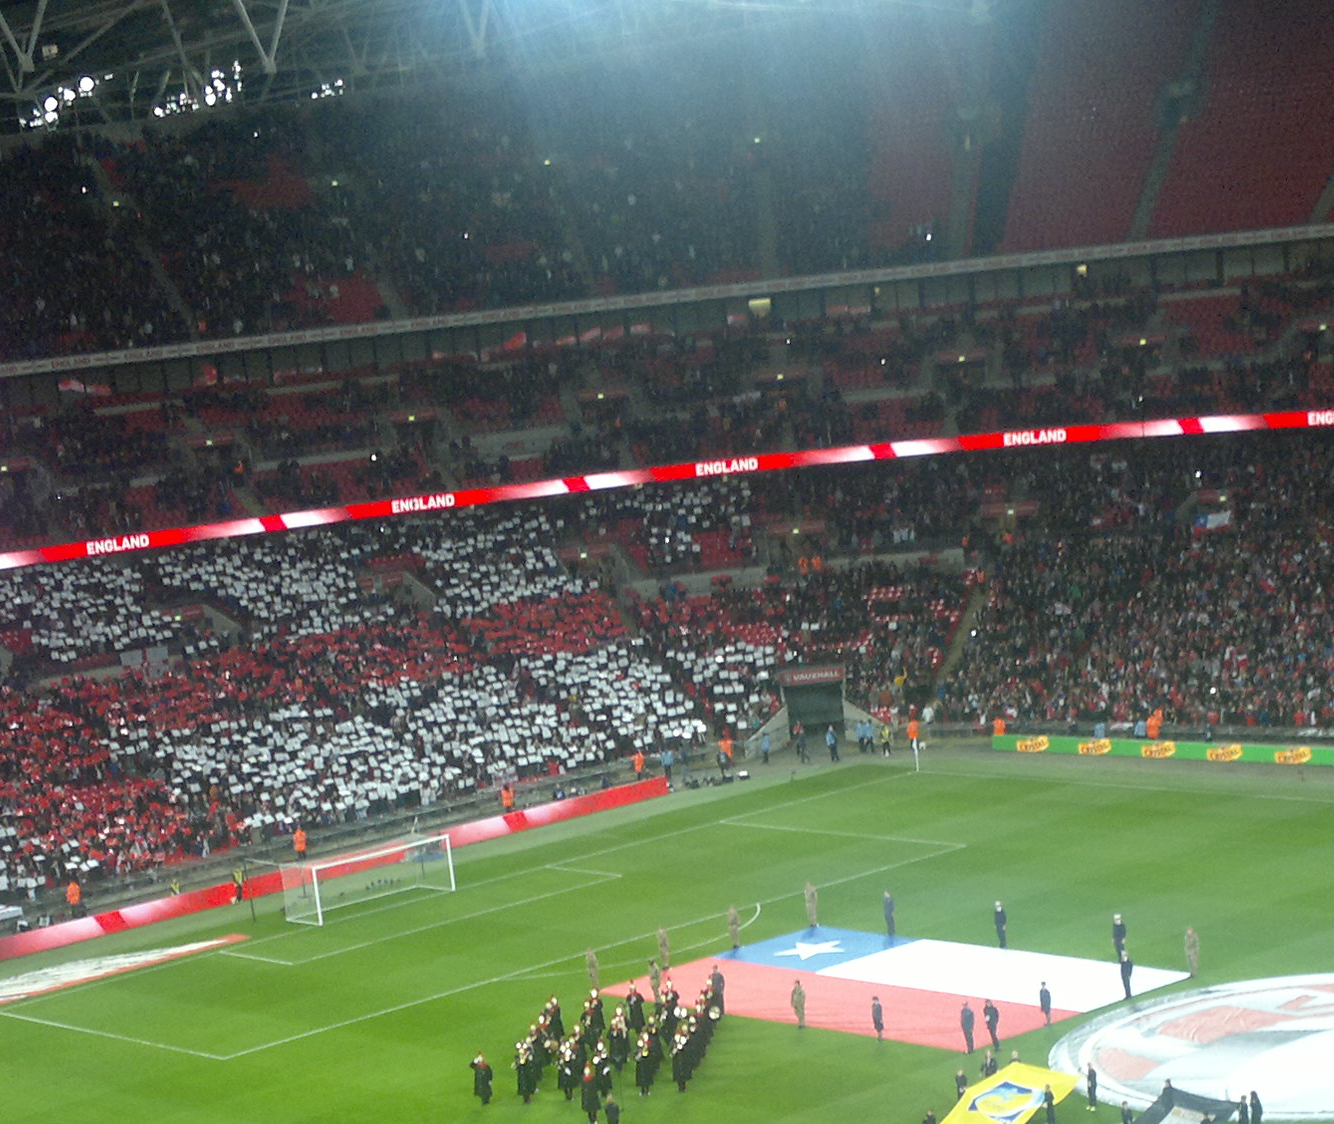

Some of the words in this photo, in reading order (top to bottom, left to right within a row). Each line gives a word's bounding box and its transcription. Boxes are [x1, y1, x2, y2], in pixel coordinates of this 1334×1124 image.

[87, 534, 150, 555] ENGLAND
[391, 494, 455, 514] ENGLAND
[695, 458, 758, 477] ENGLAND
[1003, 429, 1066, 446] ENGLAND
[793, 669, 839, 681] VAUXHALL
[1277, 749, 1309, 763] CRISTAL
